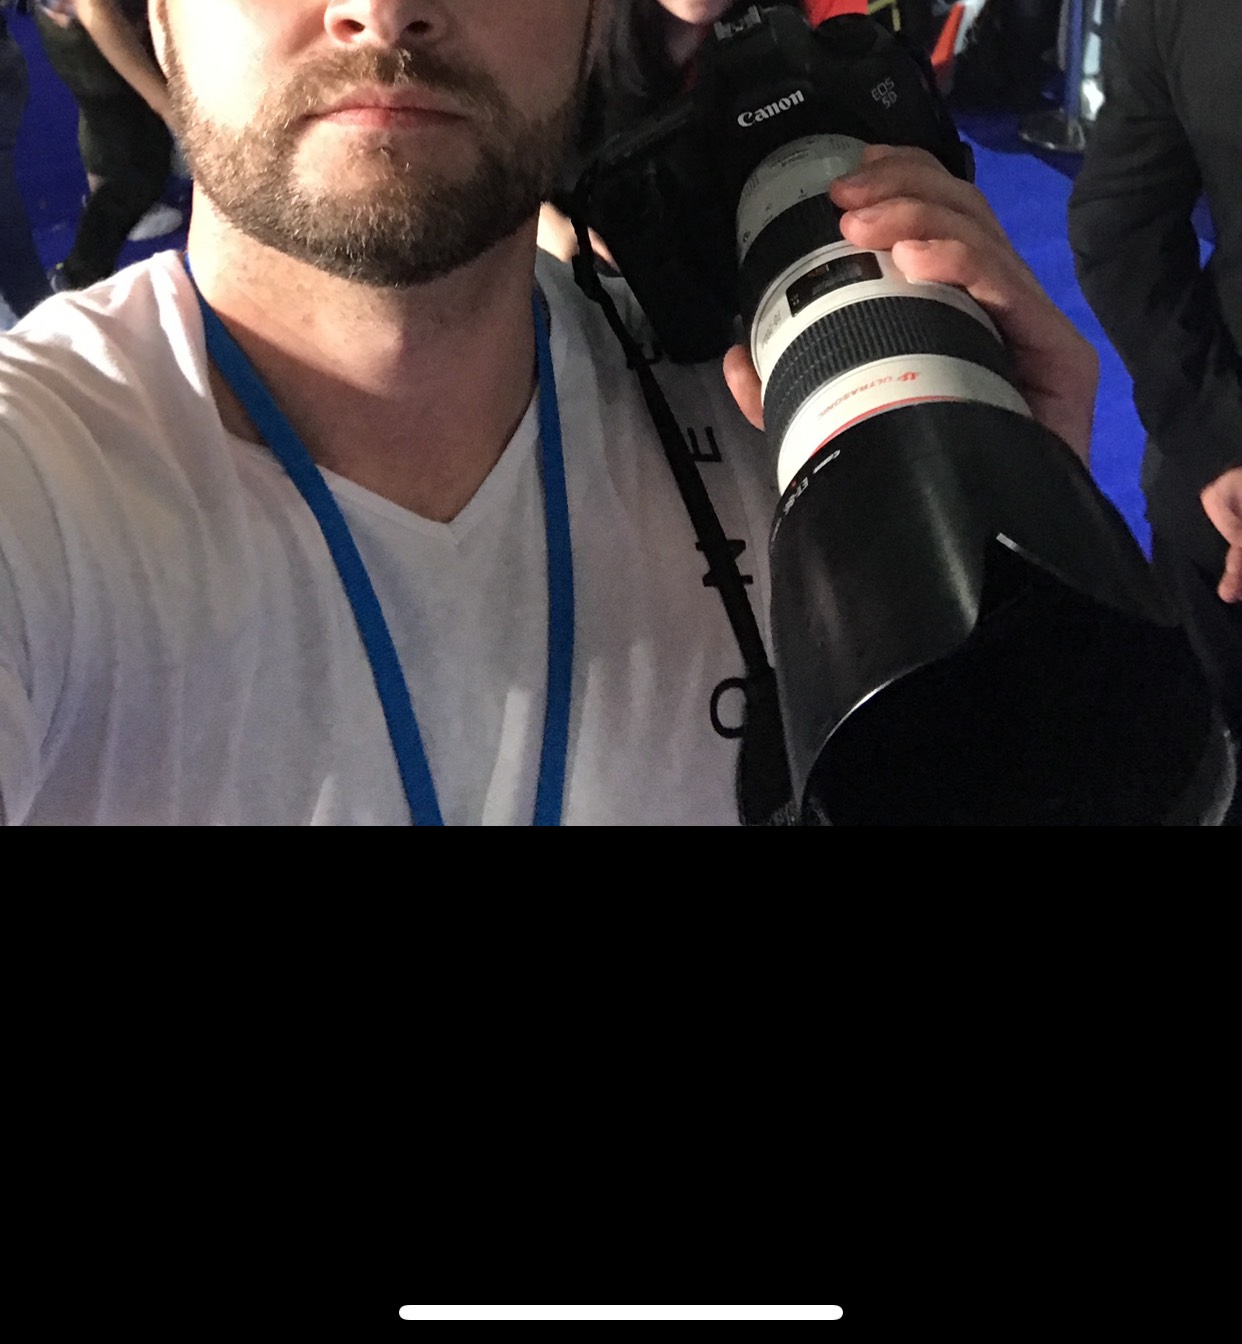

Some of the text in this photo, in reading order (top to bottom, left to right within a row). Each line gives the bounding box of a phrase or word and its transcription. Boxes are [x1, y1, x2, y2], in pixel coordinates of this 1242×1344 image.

[871, 77, 895, 101] EOS
[881, 90, 898, 109] 5D
[737, 90, 805, 128] Canon
[818, 376, 893, 418] ULTRASONIC
